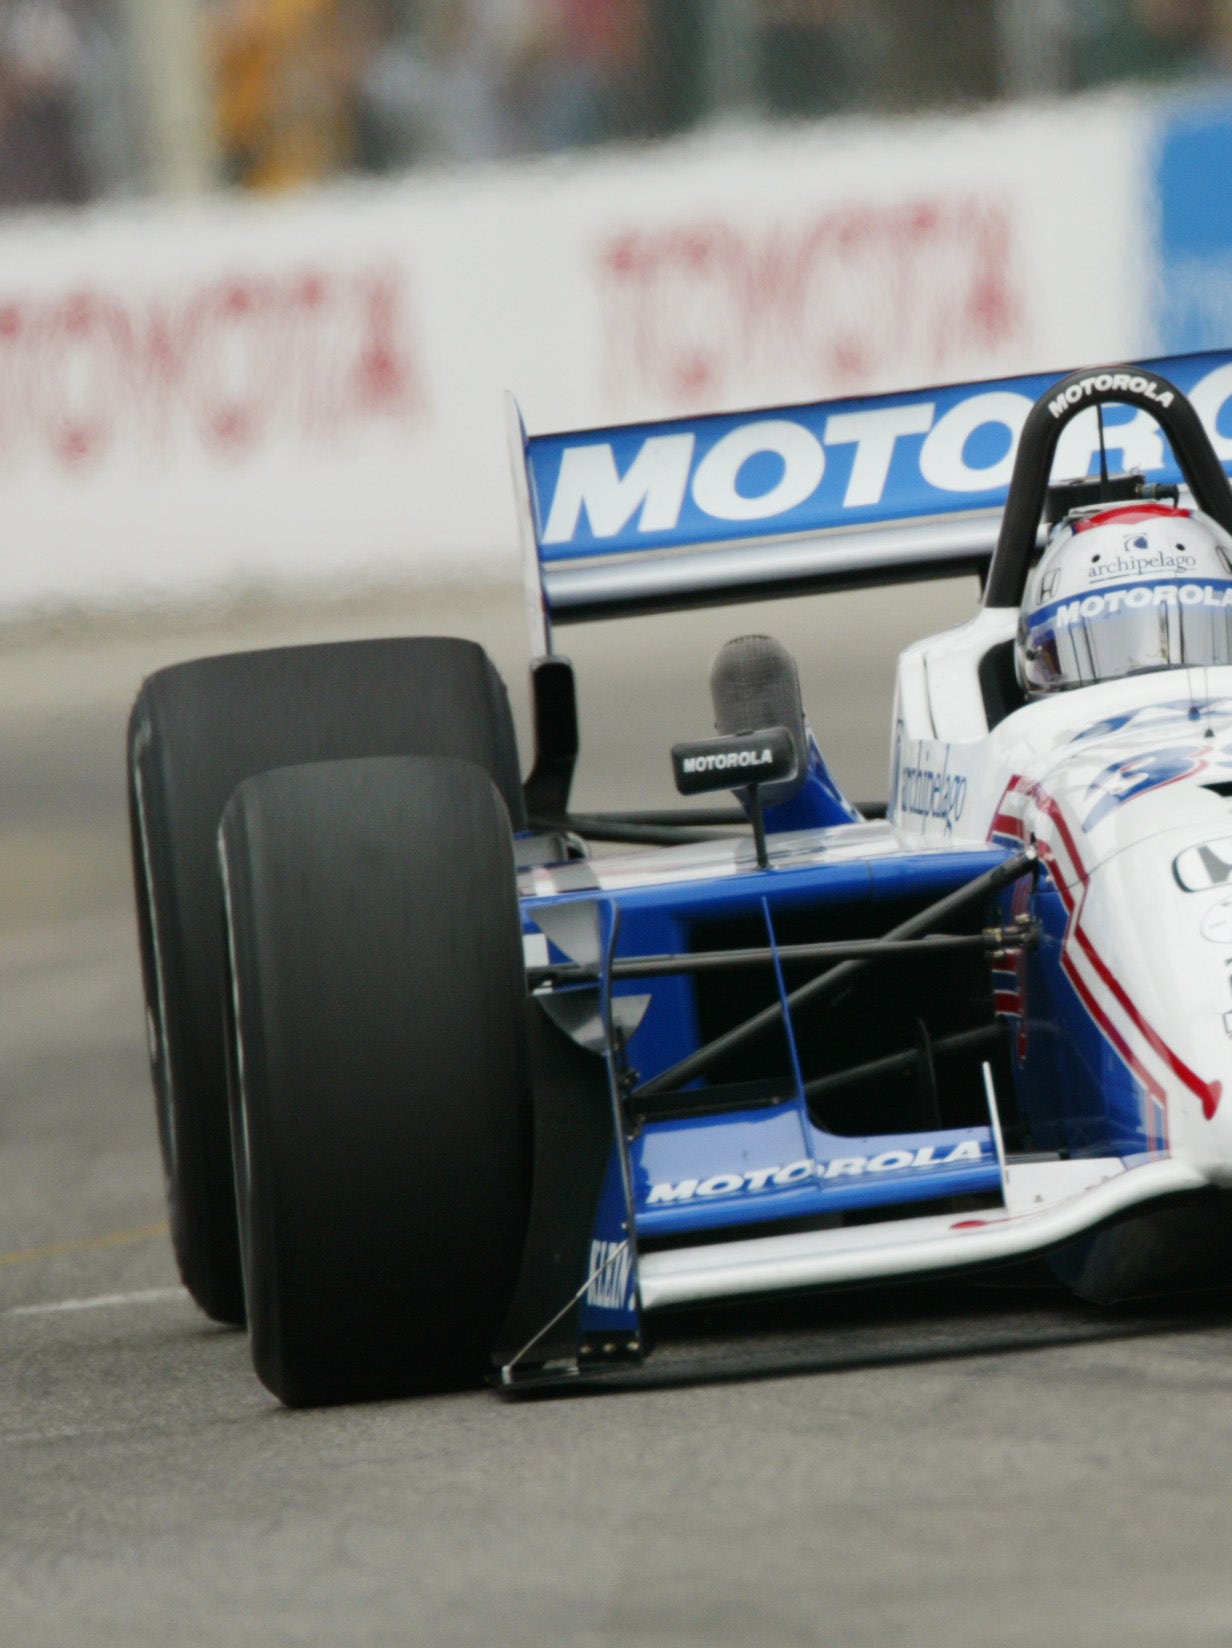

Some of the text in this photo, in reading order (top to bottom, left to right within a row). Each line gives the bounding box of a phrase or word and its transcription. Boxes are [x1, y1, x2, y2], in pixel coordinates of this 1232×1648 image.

[1048, 374, 1174, 418] MOTOROLA
[1088, 552, 1196, 579] archipelago
[683, 749, 773, 773] MOTOROLA
[646, 1140, 983, 1204] MOTOROLA
